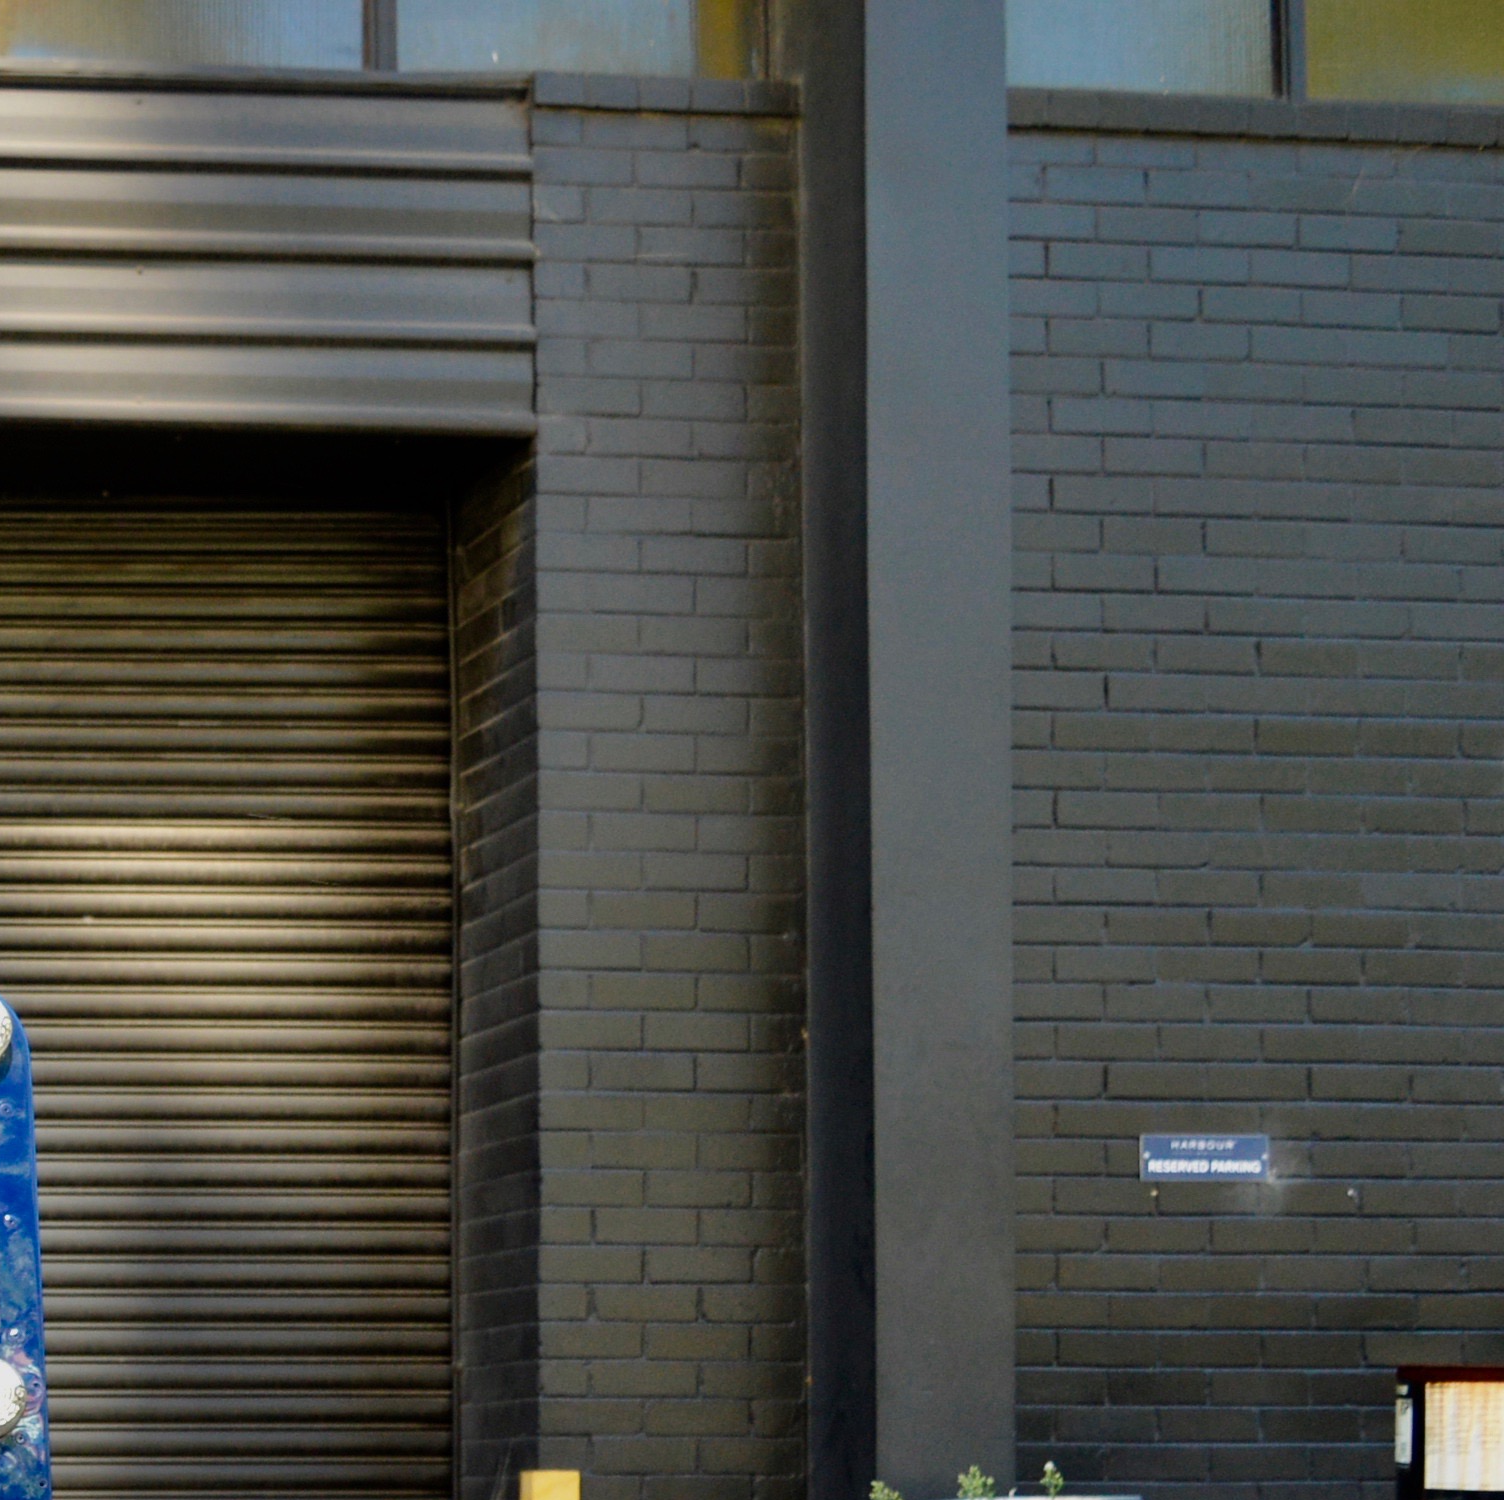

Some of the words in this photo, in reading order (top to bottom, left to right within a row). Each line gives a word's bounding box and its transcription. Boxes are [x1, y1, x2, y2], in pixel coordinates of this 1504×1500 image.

[1170, 1139, 1237, 1151] HARBOUR
[1147, 1159, 1209, 1174] RESERVED
[1210, 1159, 1262, 1174] PARKING
